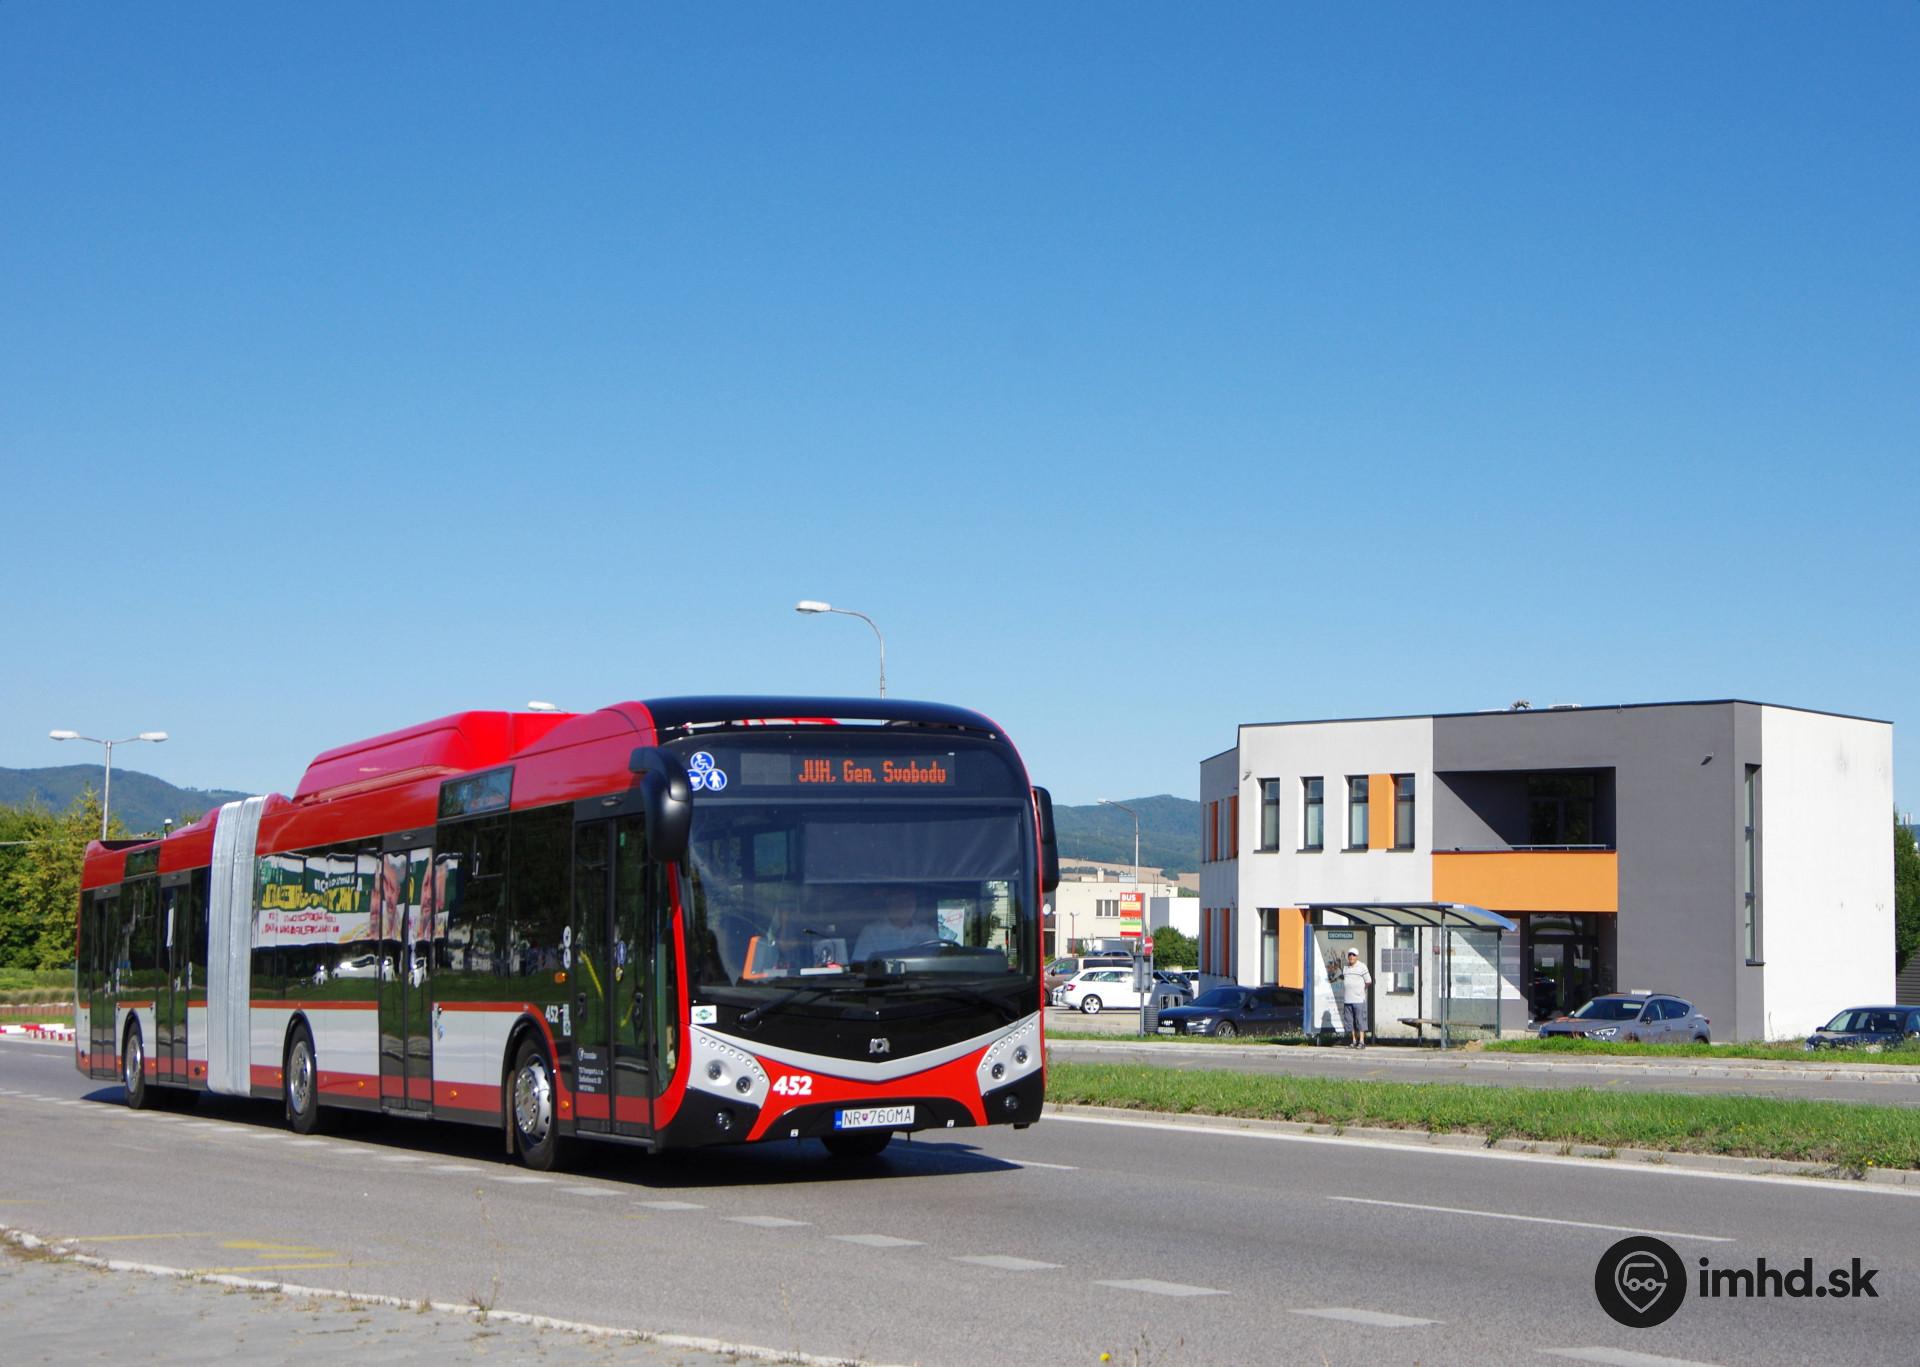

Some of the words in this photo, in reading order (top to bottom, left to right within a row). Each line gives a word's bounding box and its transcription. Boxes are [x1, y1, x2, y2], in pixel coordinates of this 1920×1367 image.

[799, 759, 836, 783] JUH,
[843, 759, 877, 783] Gen.
[882, 759, 947, 783] Svobodu
[1121, 893, 1136, 902] BUS
[545, 1004, 559, 1023] 452
[773, 1075, 812, 1096] 452
